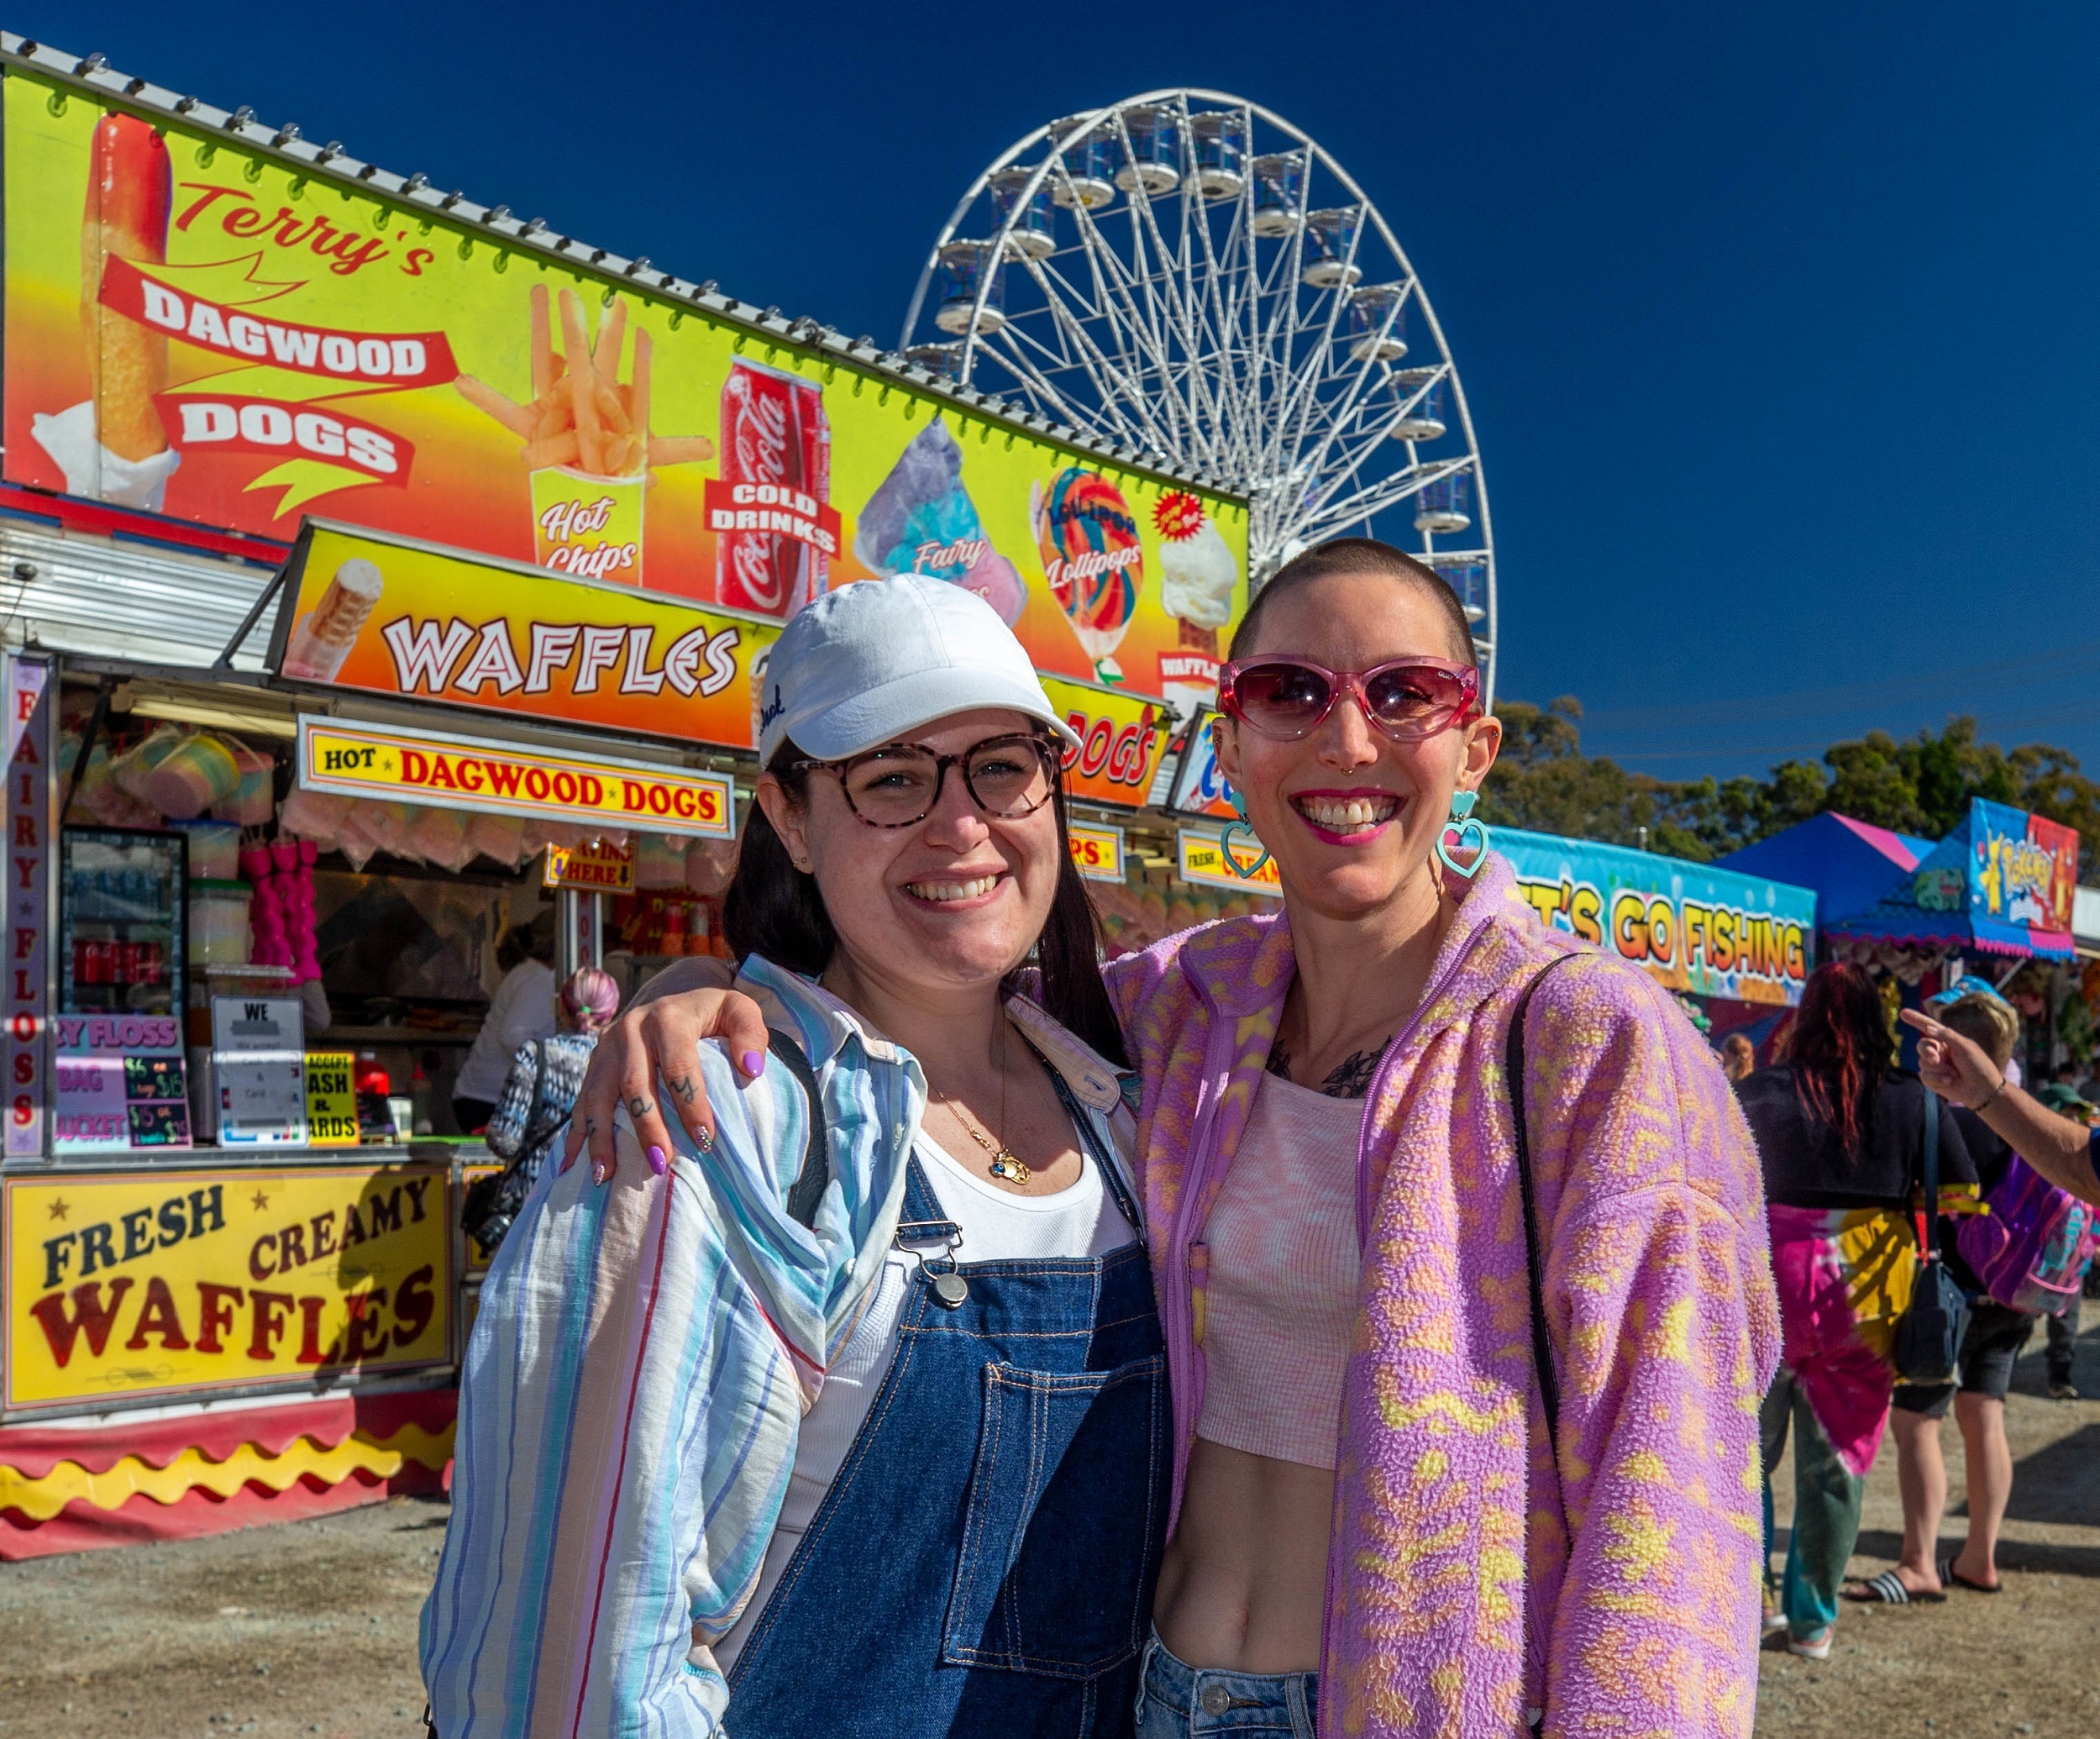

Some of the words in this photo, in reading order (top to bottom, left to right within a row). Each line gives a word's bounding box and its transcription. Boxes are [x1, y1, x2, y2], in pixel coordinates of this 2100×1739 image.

[176, 181, 434, 276] Terry's
[141, 279, 427, 376] DAGWOOD
[179, 403, 398, 473] DOGS
[539, 496, 617, 543] Hot
[733, 484, 817, 517] COLD
[711, 509, 836, 554] DRINKS
[545, 540, 638, 580] Chips
[913, 539, 987, 575] Fairy
[1046, 544, 1142, 589] Lollipops
[382, 616, 740, 697] WAFFLES
[13, 689, 40, 891] FAIRY
[324, 748, 375, 770] HOT
[400, 749, 603, 806] DAGWOOD
[622, 780, 716, 820] DOGS
[568, 862, 617, 884] HERE
[1614, 894, 1674, 963] GO
[1683, 901, 1806, 981] FISHING
[12, 927, 39, 1127] FLOSS
[88, 1019, 177, 1048] FLOSS
[244, 1003, 268, 1021] WE
[57, 1065, 103, 1091] BAG
[307, 1073, 348, 1094] ASH
[55, 1114, 125, 1142] UCKET
[42, 1185, 225, 1289] FRESH
[249, 1178, 430, 1281] CREAMY
[30, 1264, 435, 1369] WAFFLES
